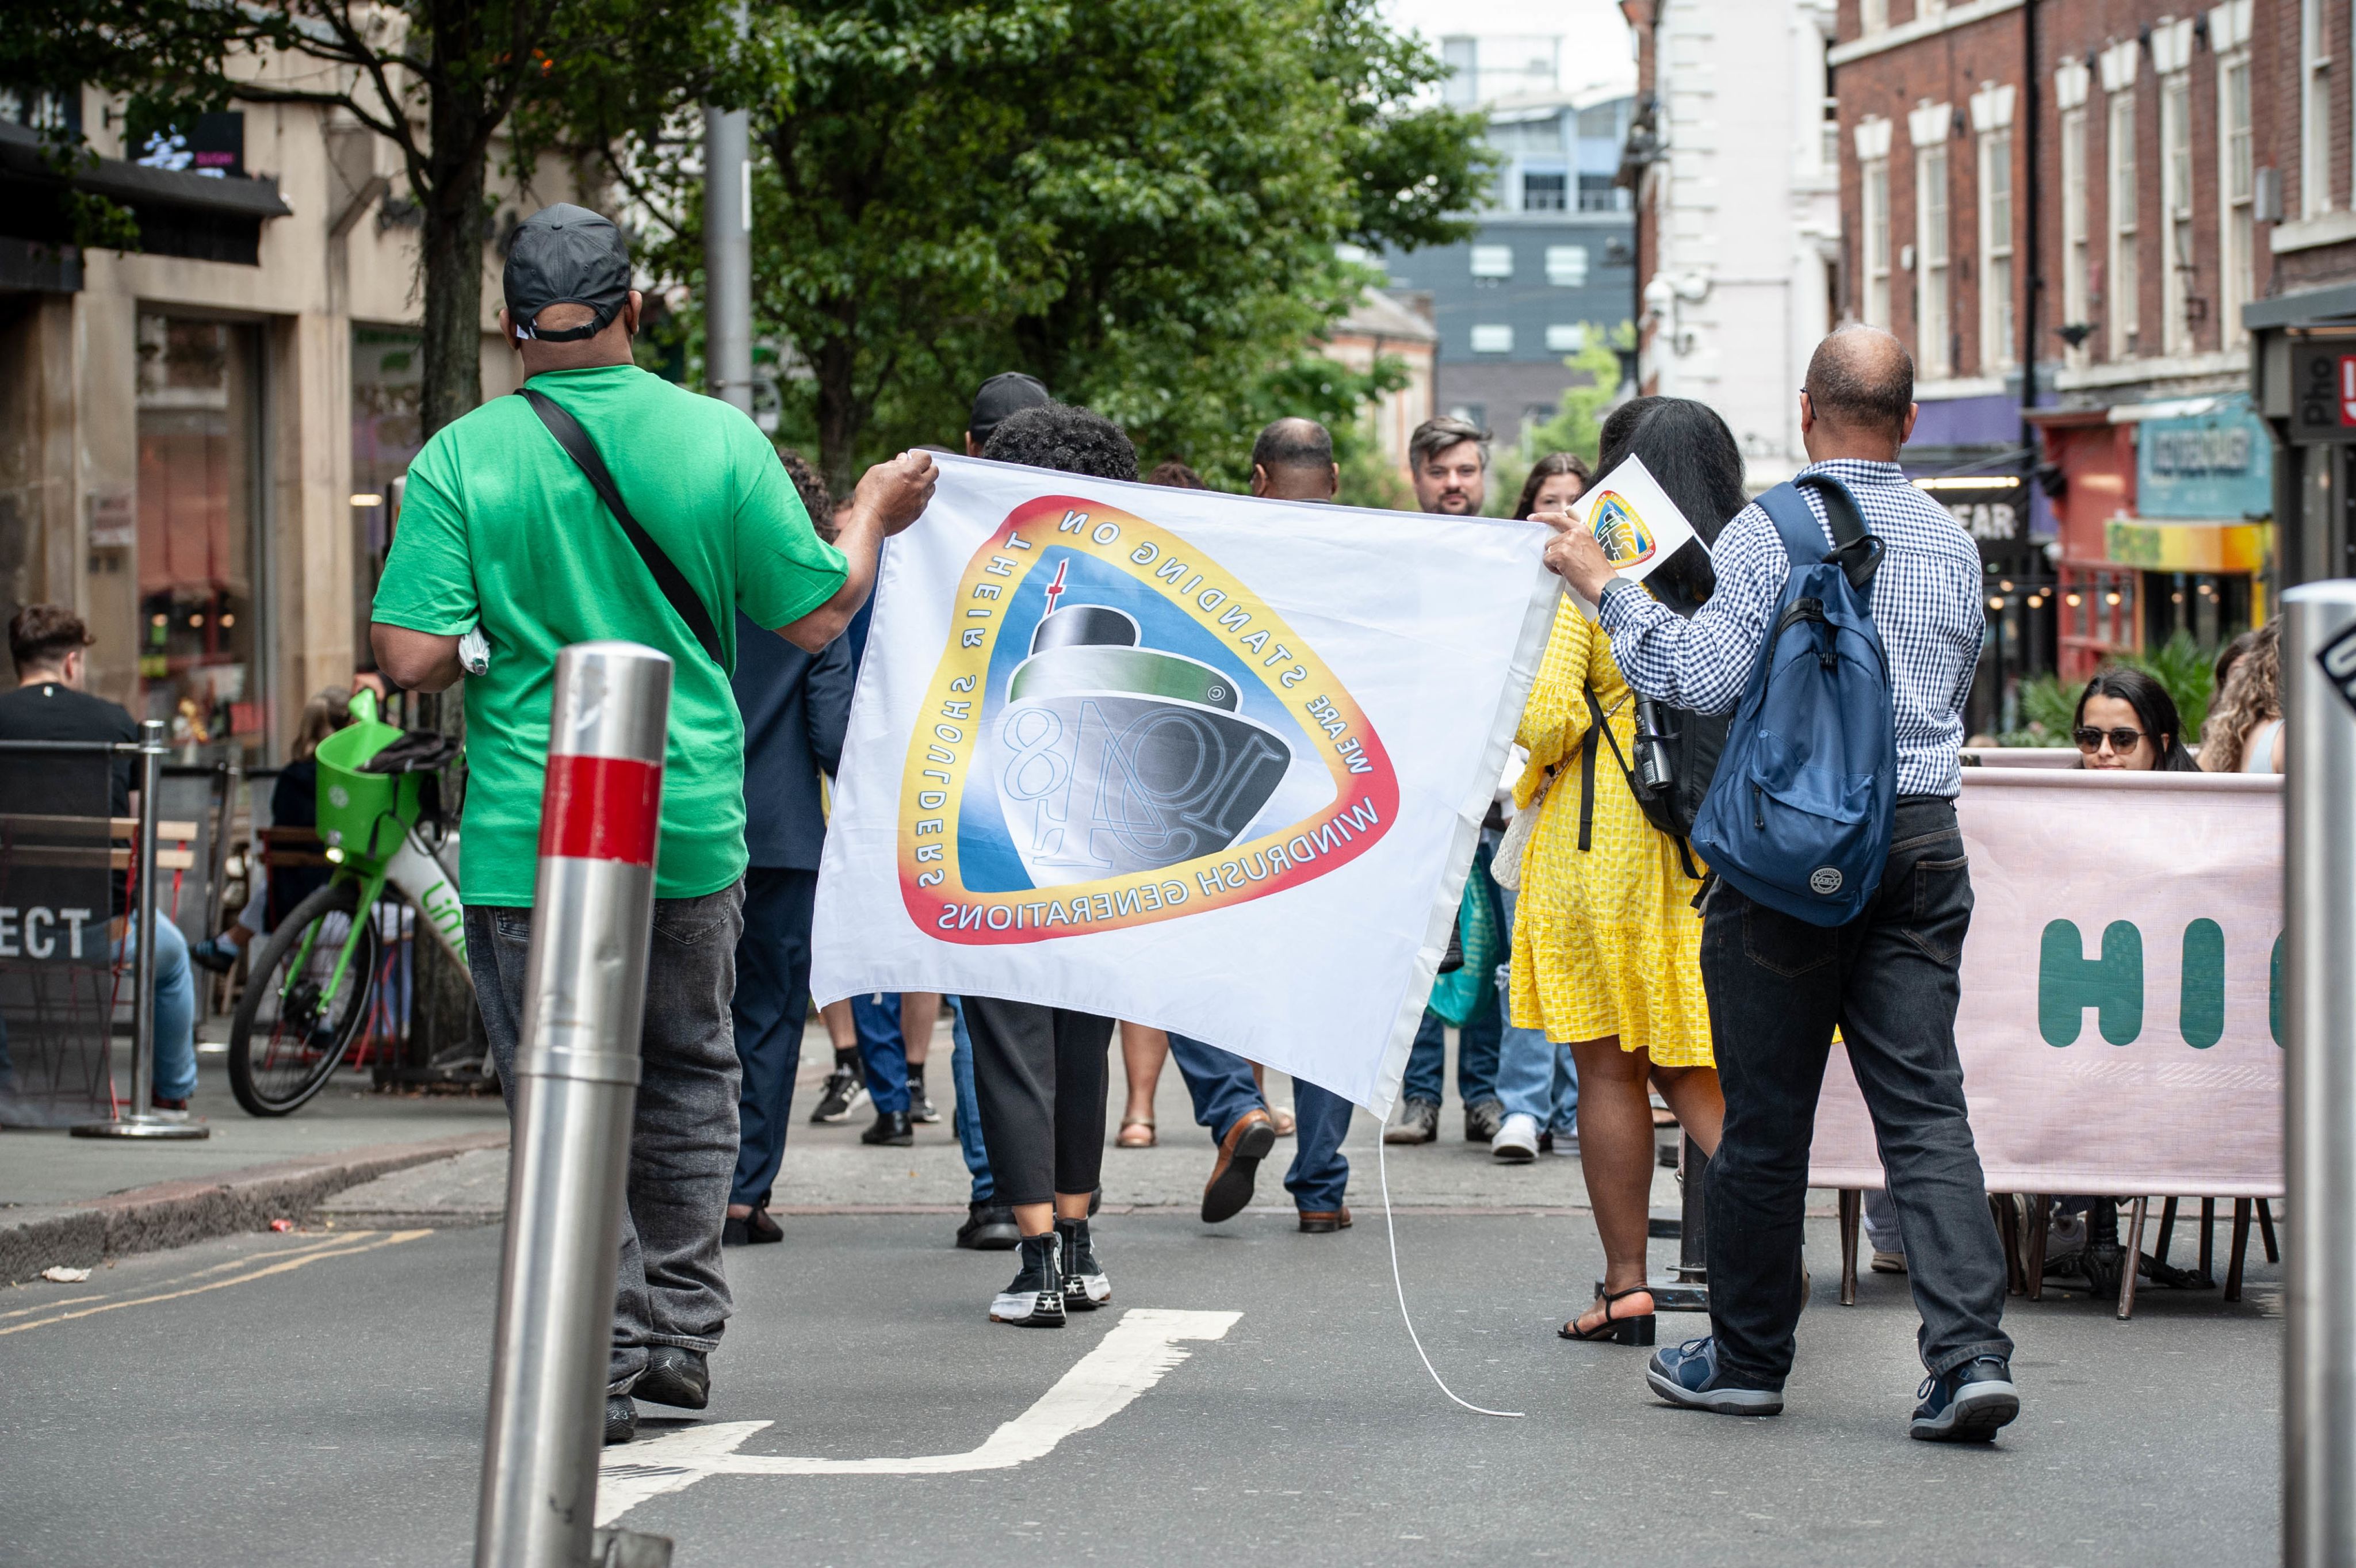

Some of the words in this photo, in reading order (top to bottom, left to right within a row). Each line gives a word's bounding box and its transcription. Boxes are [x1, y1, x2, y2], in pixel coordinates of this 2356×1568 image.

[2304, 357, 2334, 425] Pho
[1944, 503, 2015, 540] EAR
[1619, 549, 1654, 567] GENERATIONS
[0, 906, 91, 959] ECT
[2038, 917, 2286, 1049] HI
[611, 1409, 629, 1420] 23
